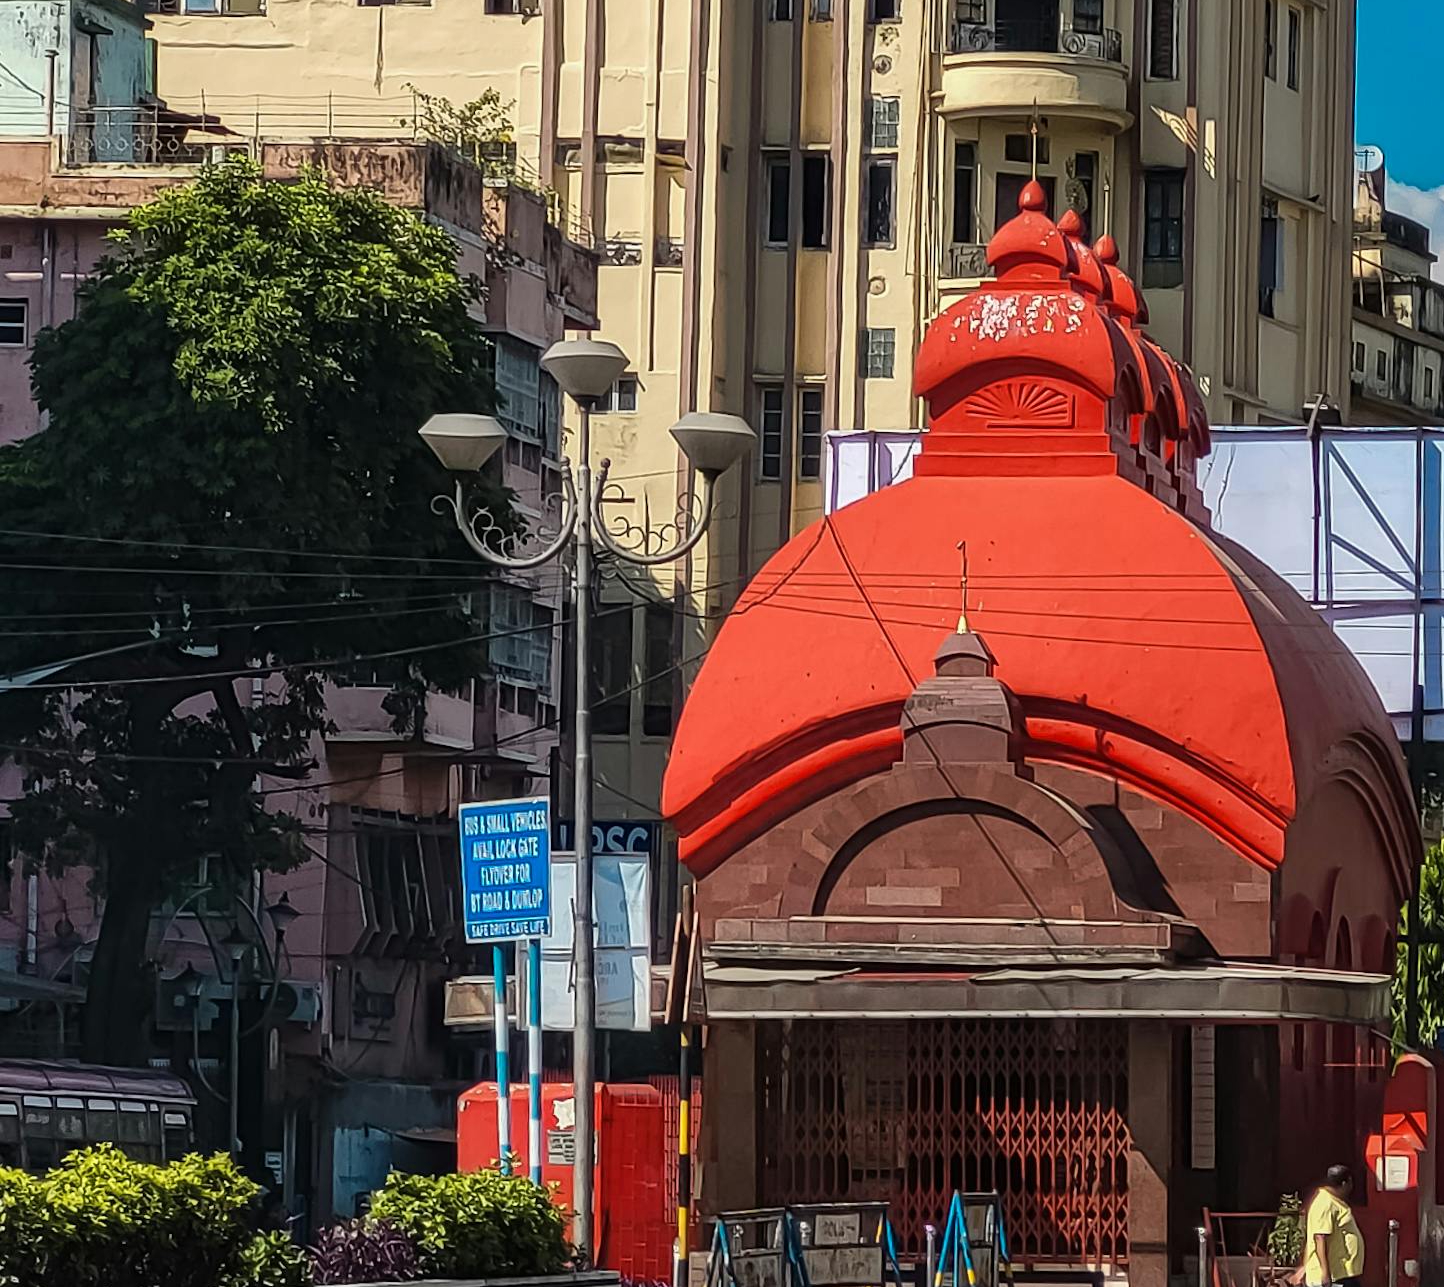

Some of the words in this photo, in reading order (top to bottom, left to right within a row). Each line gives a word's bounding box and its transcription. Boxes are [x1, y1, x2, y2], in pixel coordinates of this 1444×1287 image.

[464, 816, 479, 836] BUS
[480, 815, 485, 834] &
[486, 813, 510, 833] SMALL
[510, 810, 547, 832] VEHICLES
[473, 840, 494, 861] AVAIL
[495, 838, 517, 859] LOCK
[518, 836, 538, 858] GATE
[481, 865, 514, 887] FLYOVER
[515, 863, 531, 884] FOR
[482, 891, 503, 912] ROAD
[504, 890, 510, 910] &
[512, 888, 543, 910] DUNLOP
[471, 923, 489, 937] SAFE
[489, 922, 510, 936] DRIVE
[511, 921, 529, 934] SAVE
[529, 920, 545, 934] LIFE
